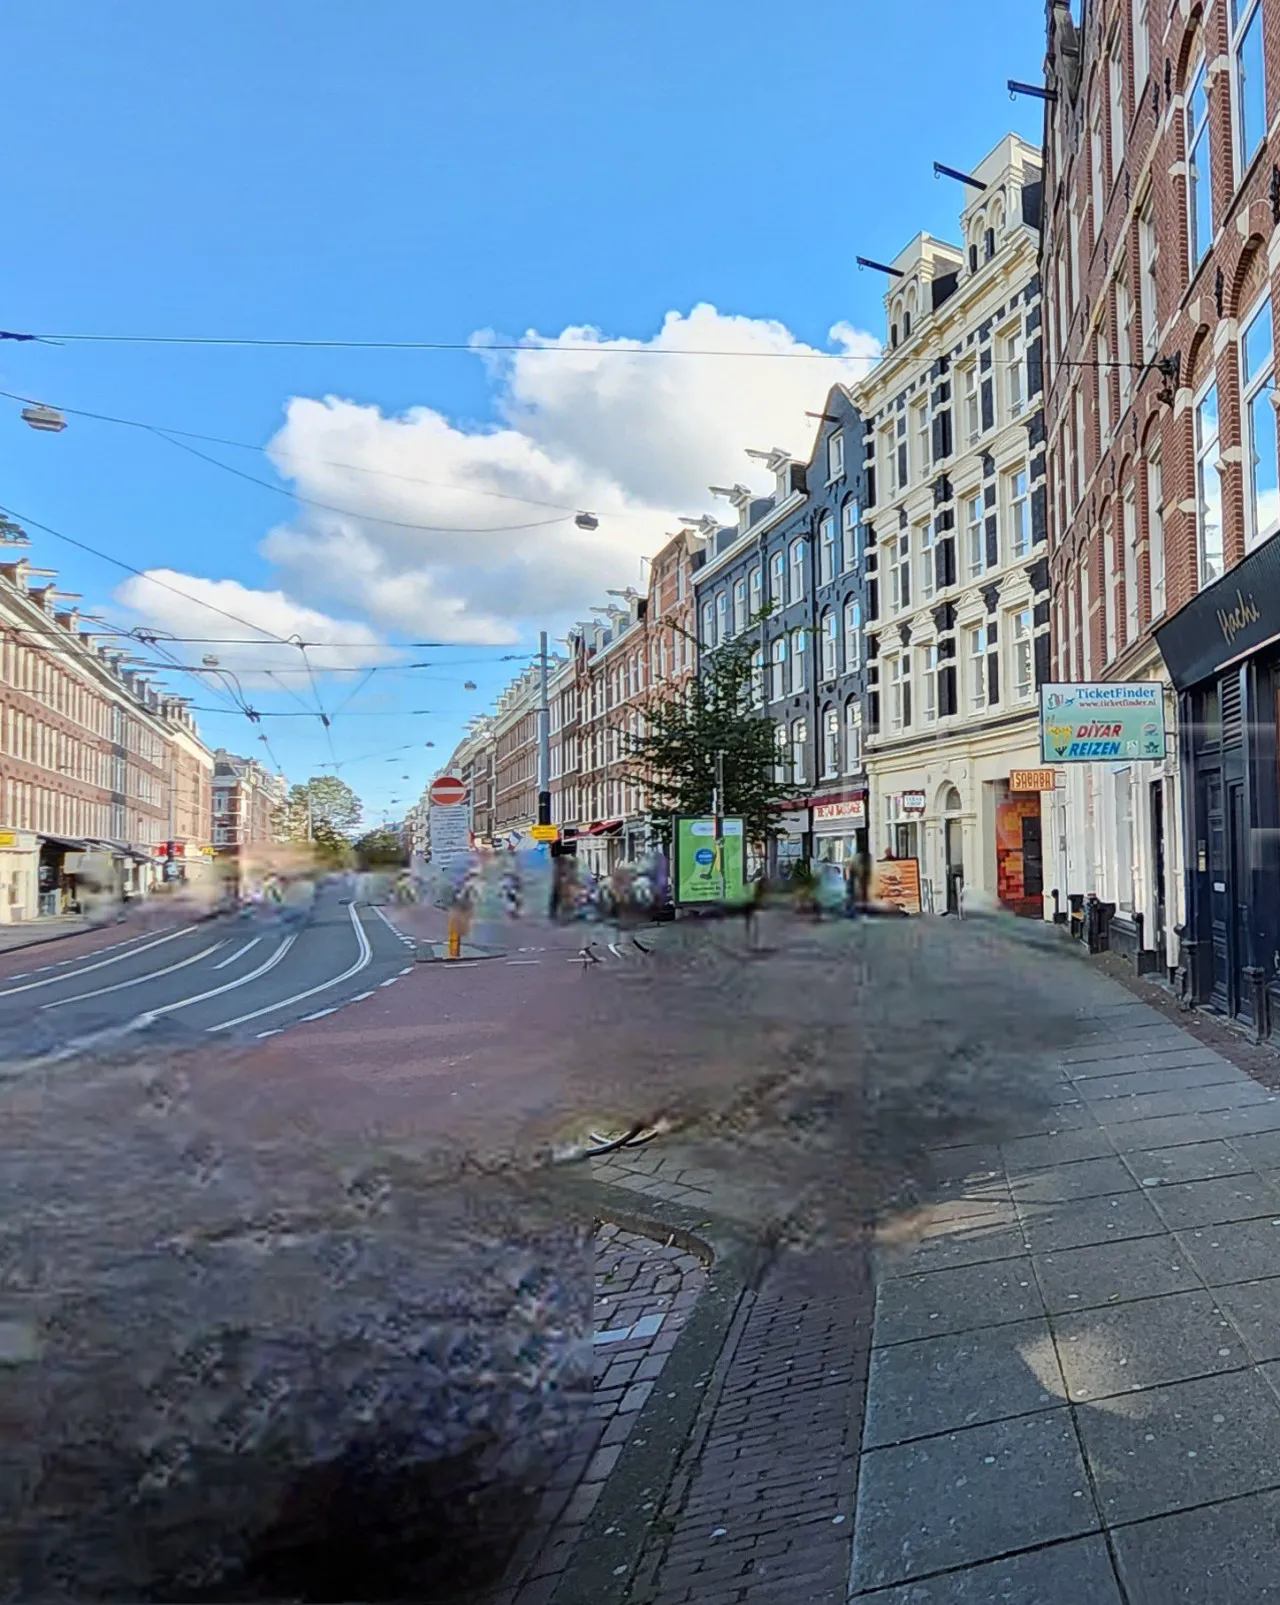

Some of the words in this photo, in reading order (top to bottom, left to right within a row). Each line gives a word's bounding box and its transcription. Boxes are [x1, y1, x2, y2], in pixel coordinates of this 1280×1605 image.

[1076, 687, 1155, 699] TicketFinder
[1080, 699, 1156, 708] www.ticketfinder.nl
[1069, 743, 1121, 756] REIZEN
[1015, 772, 1051, 788] SABABA
